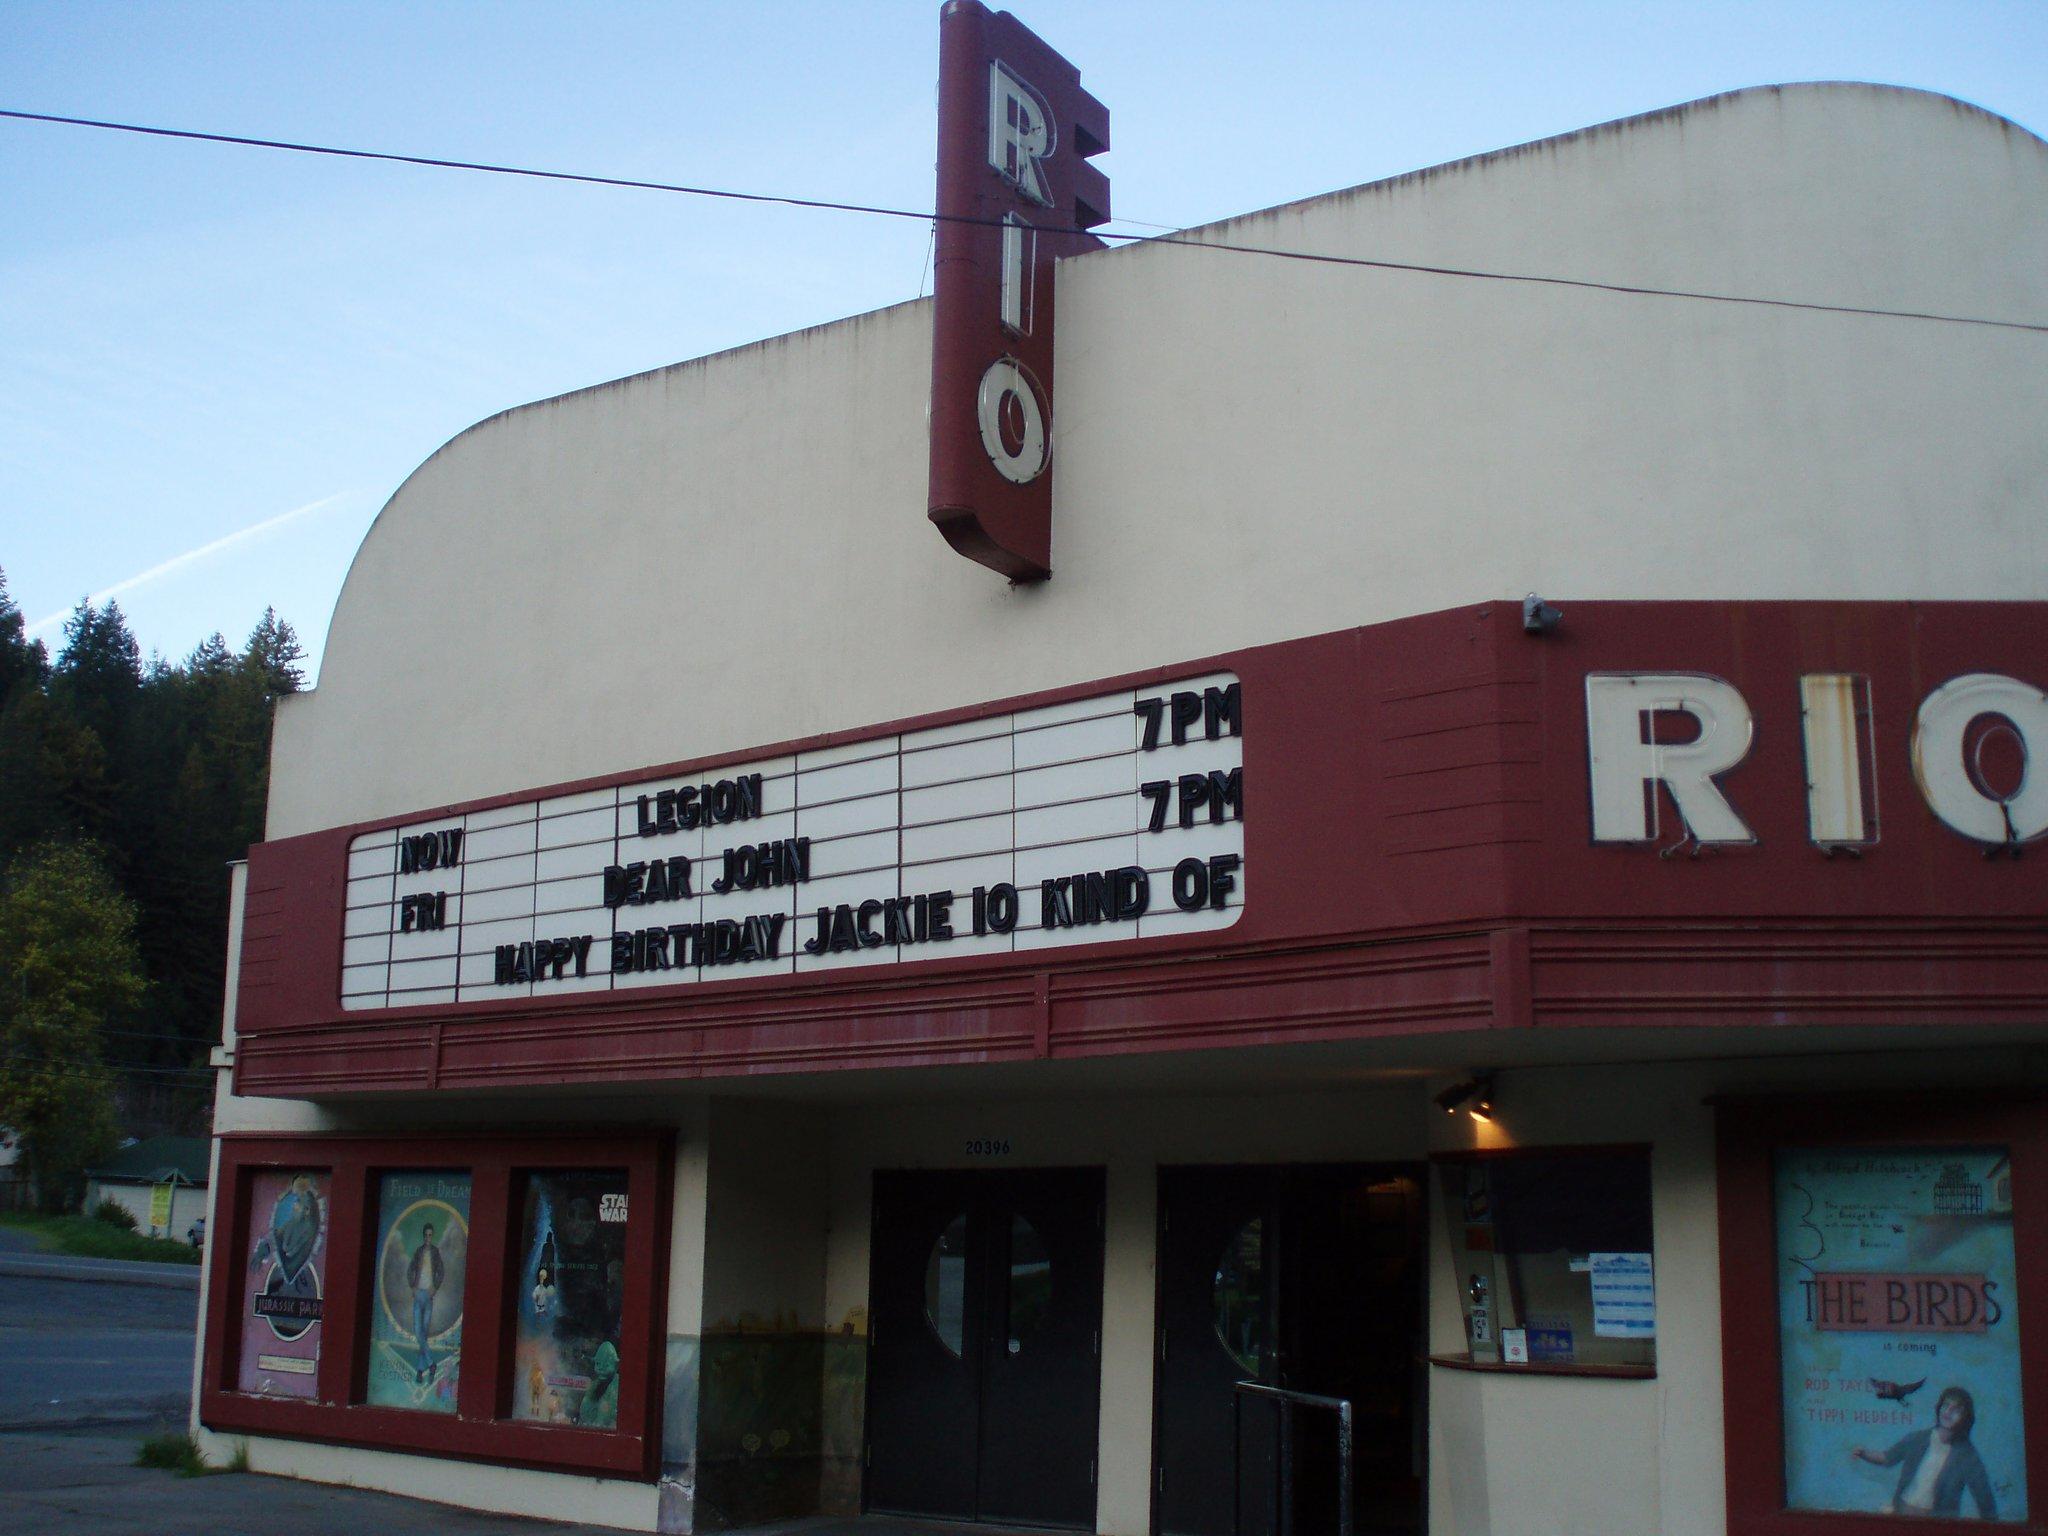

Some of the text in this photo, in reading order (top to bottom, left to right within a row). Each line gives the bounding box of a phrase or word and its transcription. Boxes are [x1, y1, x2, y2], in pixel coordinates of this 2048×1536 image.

[977, 58, 1057, 485] RIO
[1585, 671, 2048, 845] RIO
[400, 828, 462, 875] NOW
[637, 773, 762, 839] LEGION
[401, 892, 446, 933] FRI
[603, 855, 692, 909] DEAR
[711, 837, 810, 895] JOHN
[494, 935, 592, 986] HAPPY
[611, 912, 785, 975] BIRTHDAY
[804, 891, 953, 956] JACKIE
[1041, 865, 1150, 930] KIND
[1172, 853, 1239, 913] OF
[966, 1141, 1010, 1155] 20396
[600, 1194, 629, 1208] STA
[257, 1298, 295, 1313] JURASSIC
[1800, 1280, 2002, 1326] THE BIRDS
[1898, 1343, 1937, 1356] coming
